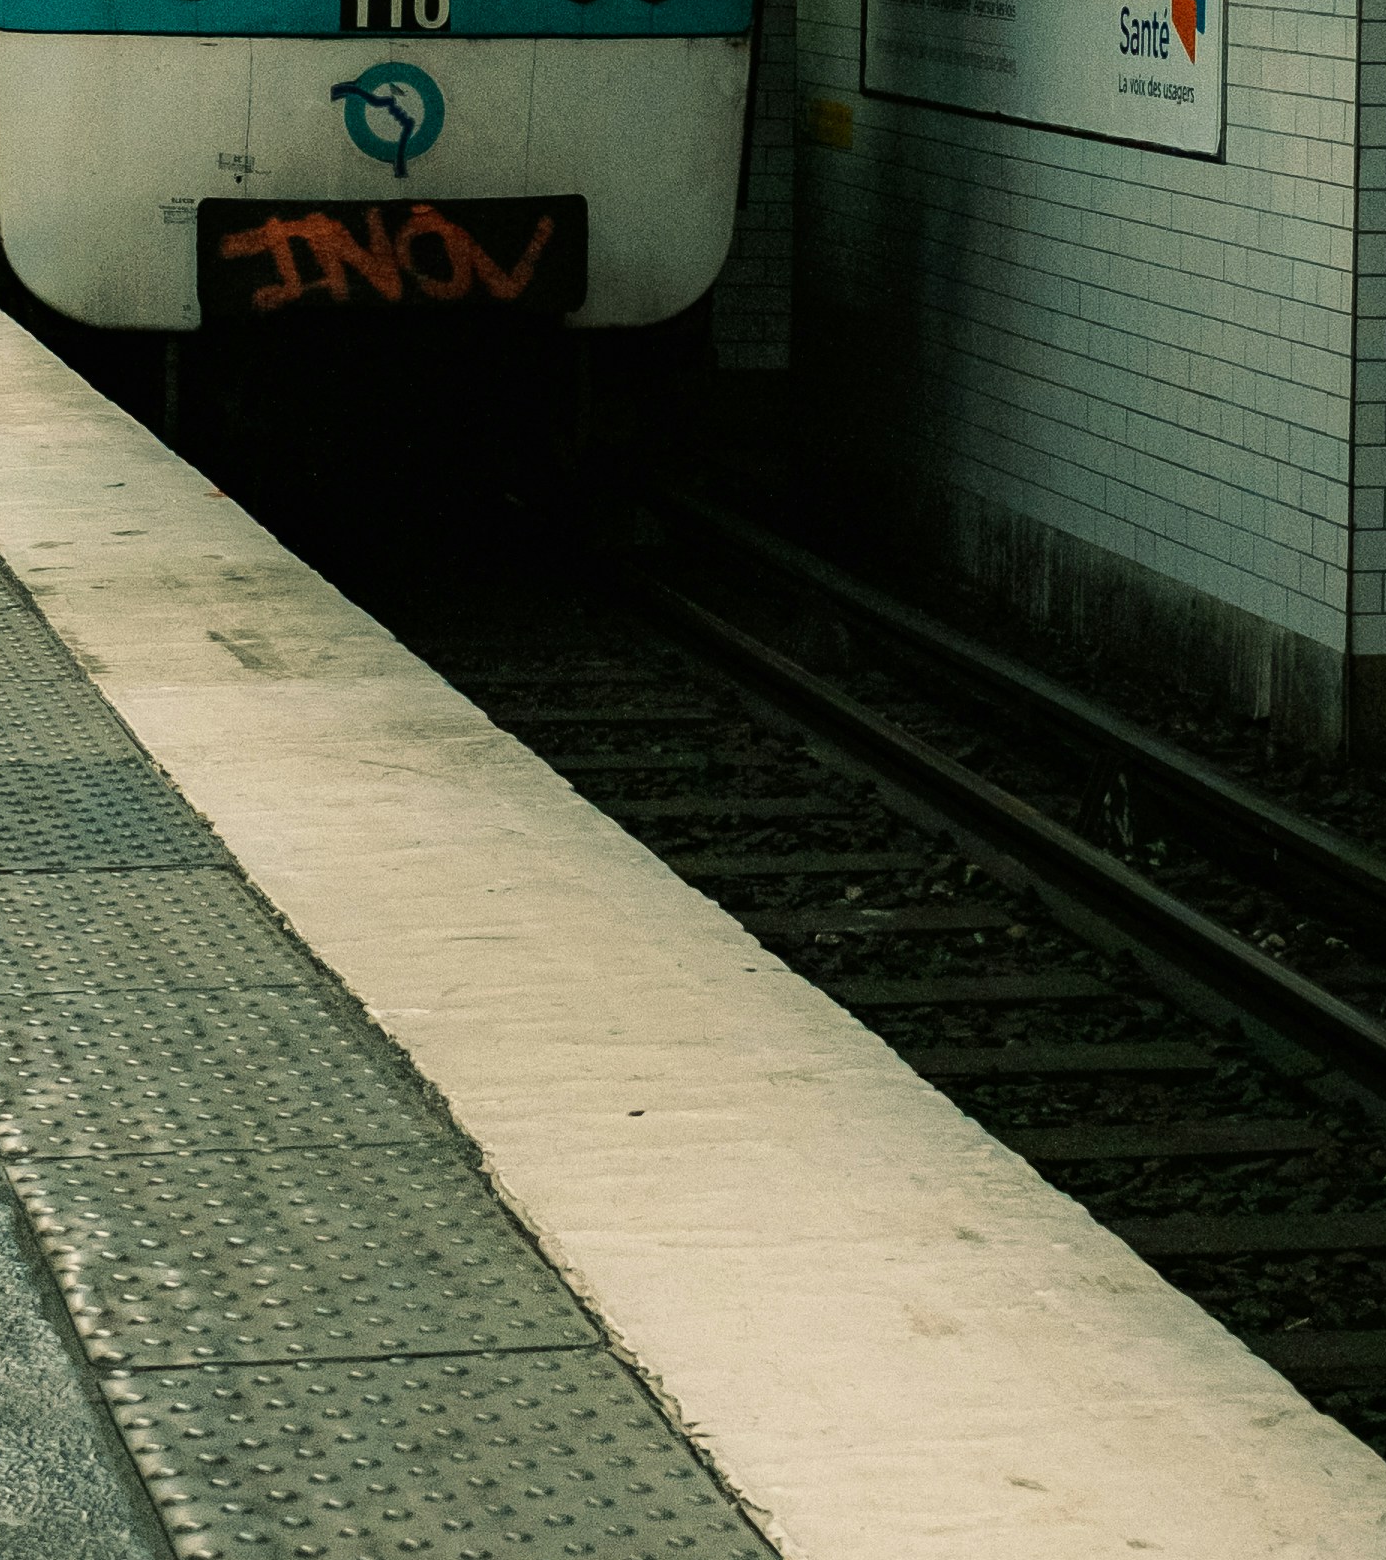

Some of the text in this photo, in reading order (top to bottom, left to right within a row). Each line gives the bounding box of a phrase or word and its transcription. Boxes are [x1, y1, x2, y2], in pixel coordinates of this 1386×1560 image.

[1120, 7, 1170, 59] Santé
[1118, 74, 1195, 105] La voix des usagers
